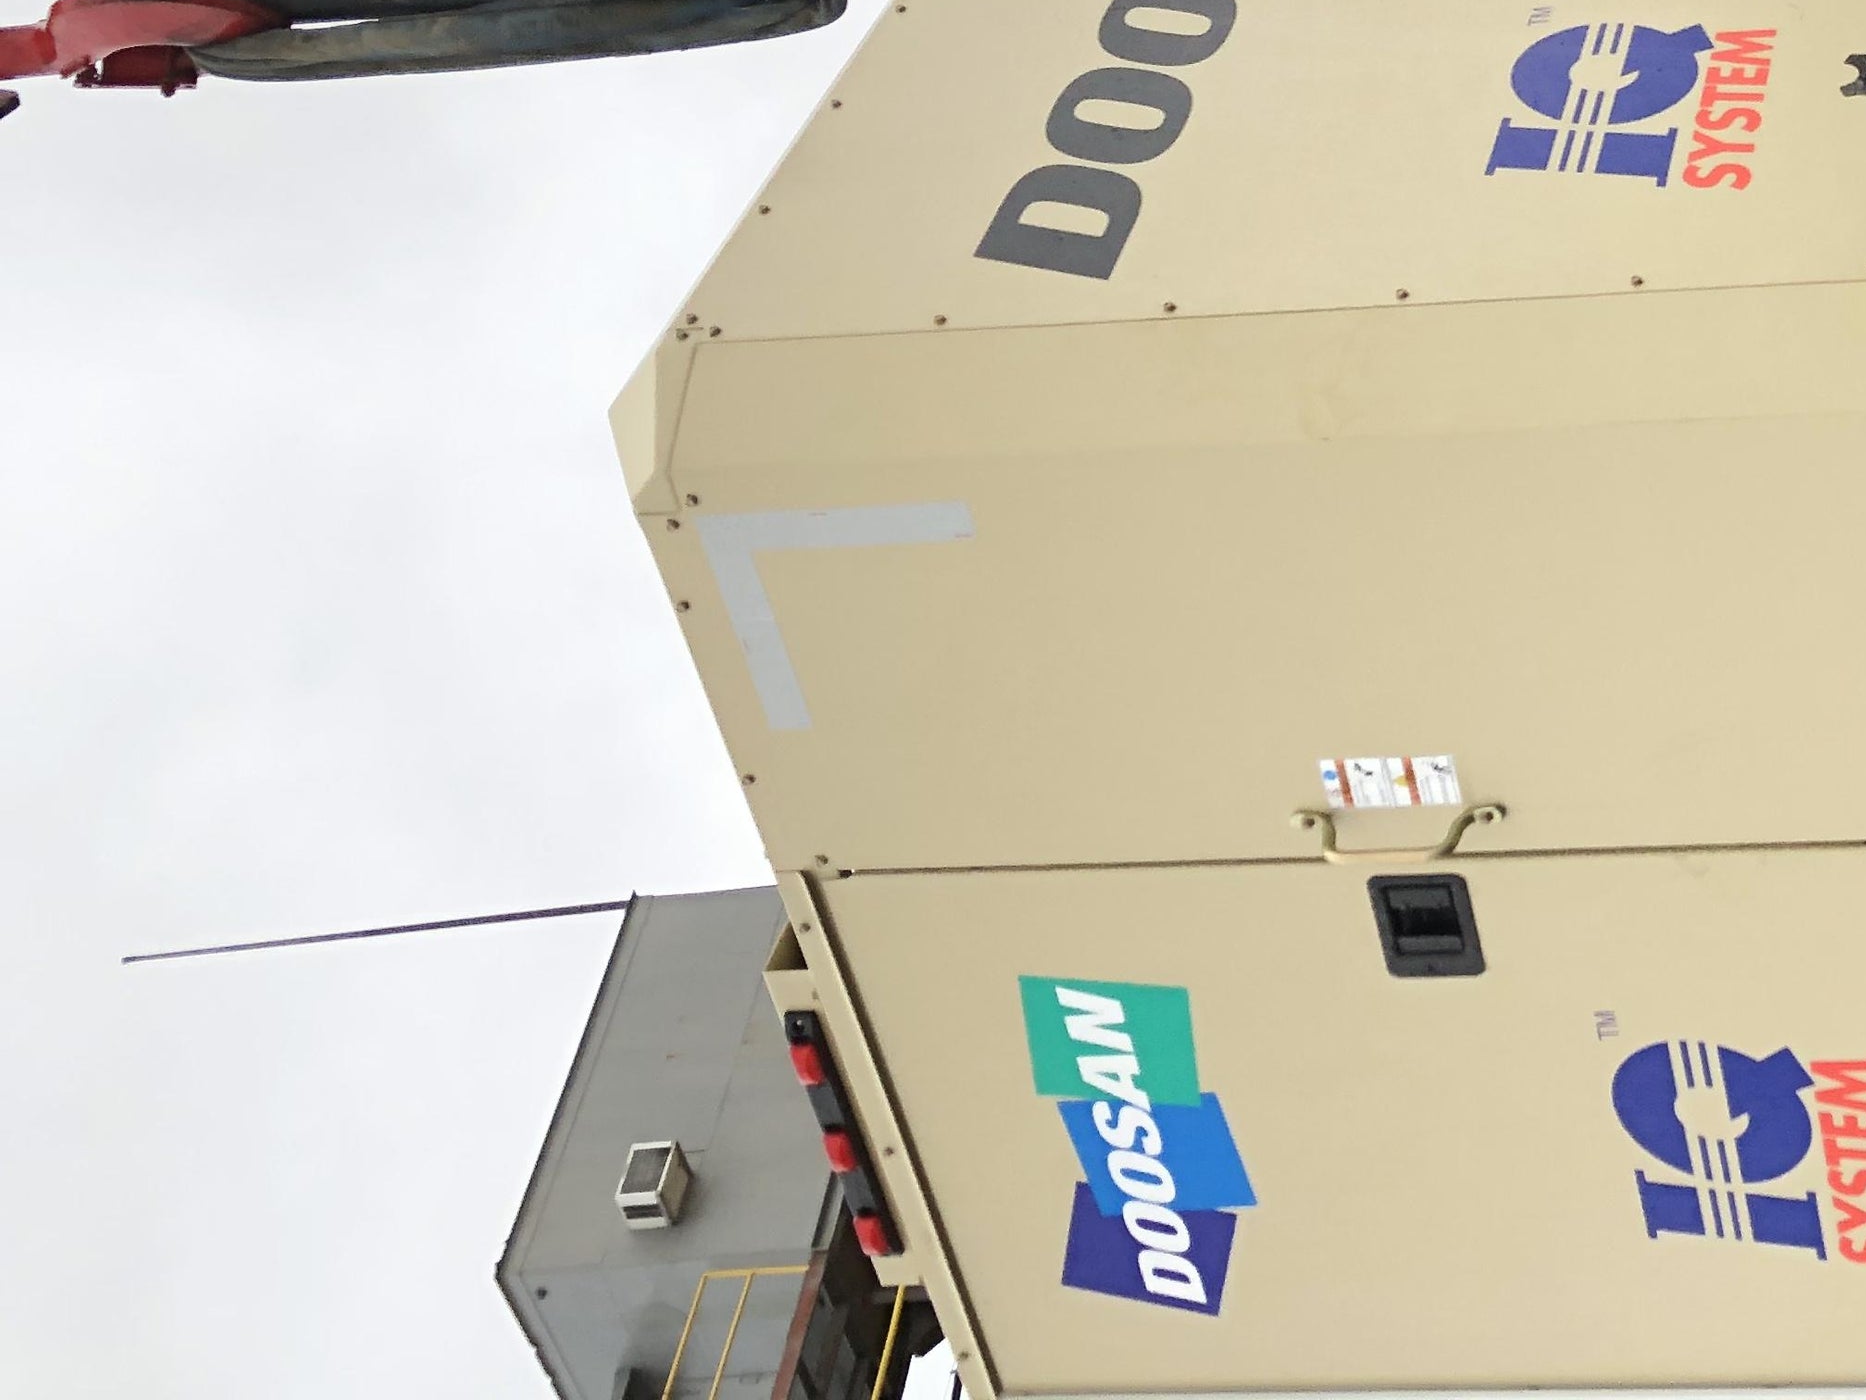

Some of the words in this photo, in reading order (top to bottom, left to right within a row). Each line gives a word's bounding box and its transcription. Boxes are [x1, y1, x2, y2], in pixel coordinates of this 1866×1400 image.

[1484, 22, 1713, 187] IQ
[1681, 28, 1777, 191] SYSTEM
[1055, 985, 1207, 1303] DOOSAN
[1611, 1039, 1827, 1261] IQ
